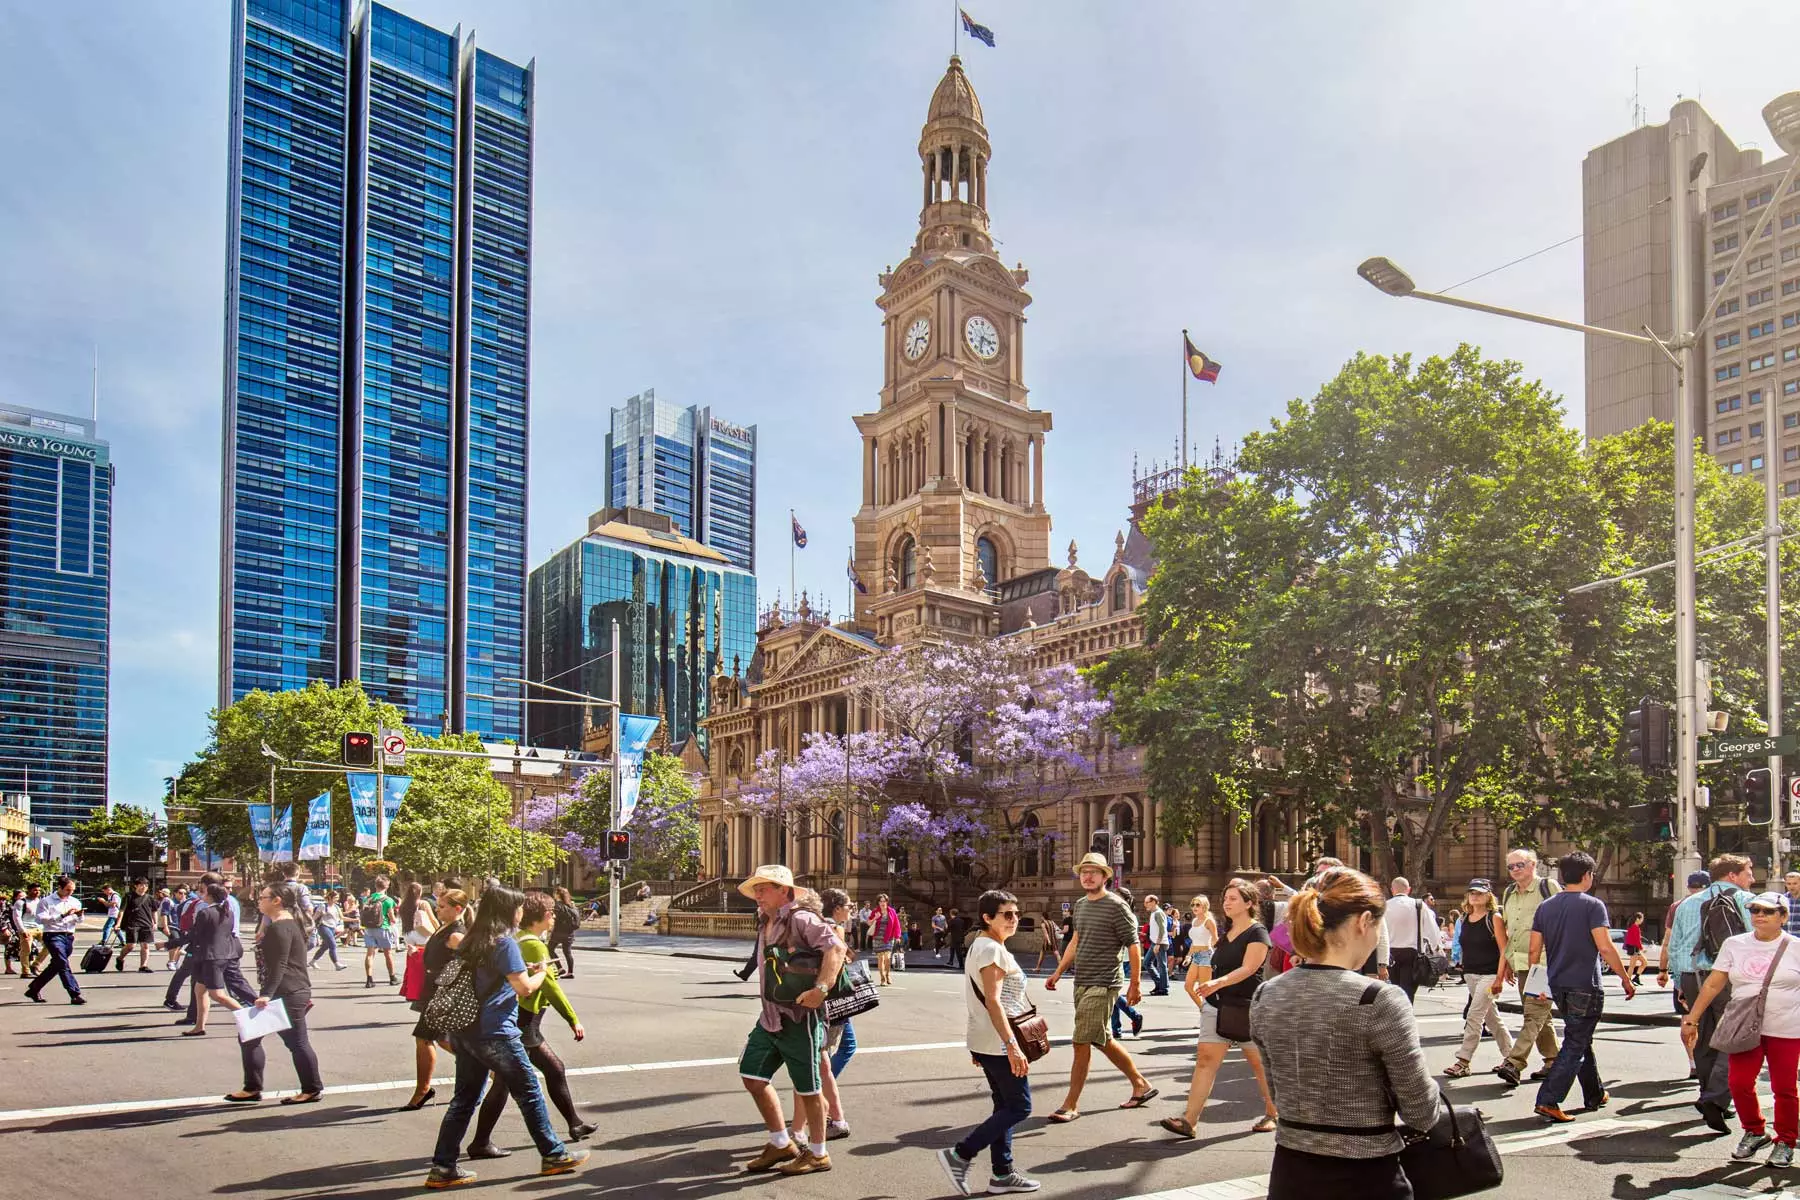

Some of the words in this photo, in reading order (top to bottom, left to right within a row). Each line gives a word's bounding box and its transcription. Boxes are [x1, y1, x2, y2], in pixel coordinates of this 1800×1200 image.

[711, 417, 752, 444] FRASER
[27, 438, 38, 448] &
[42, 438, 97, 459] YOUNG
[1718, 742, 1761, 753] George
[1764, 739, 1776, 749] St
